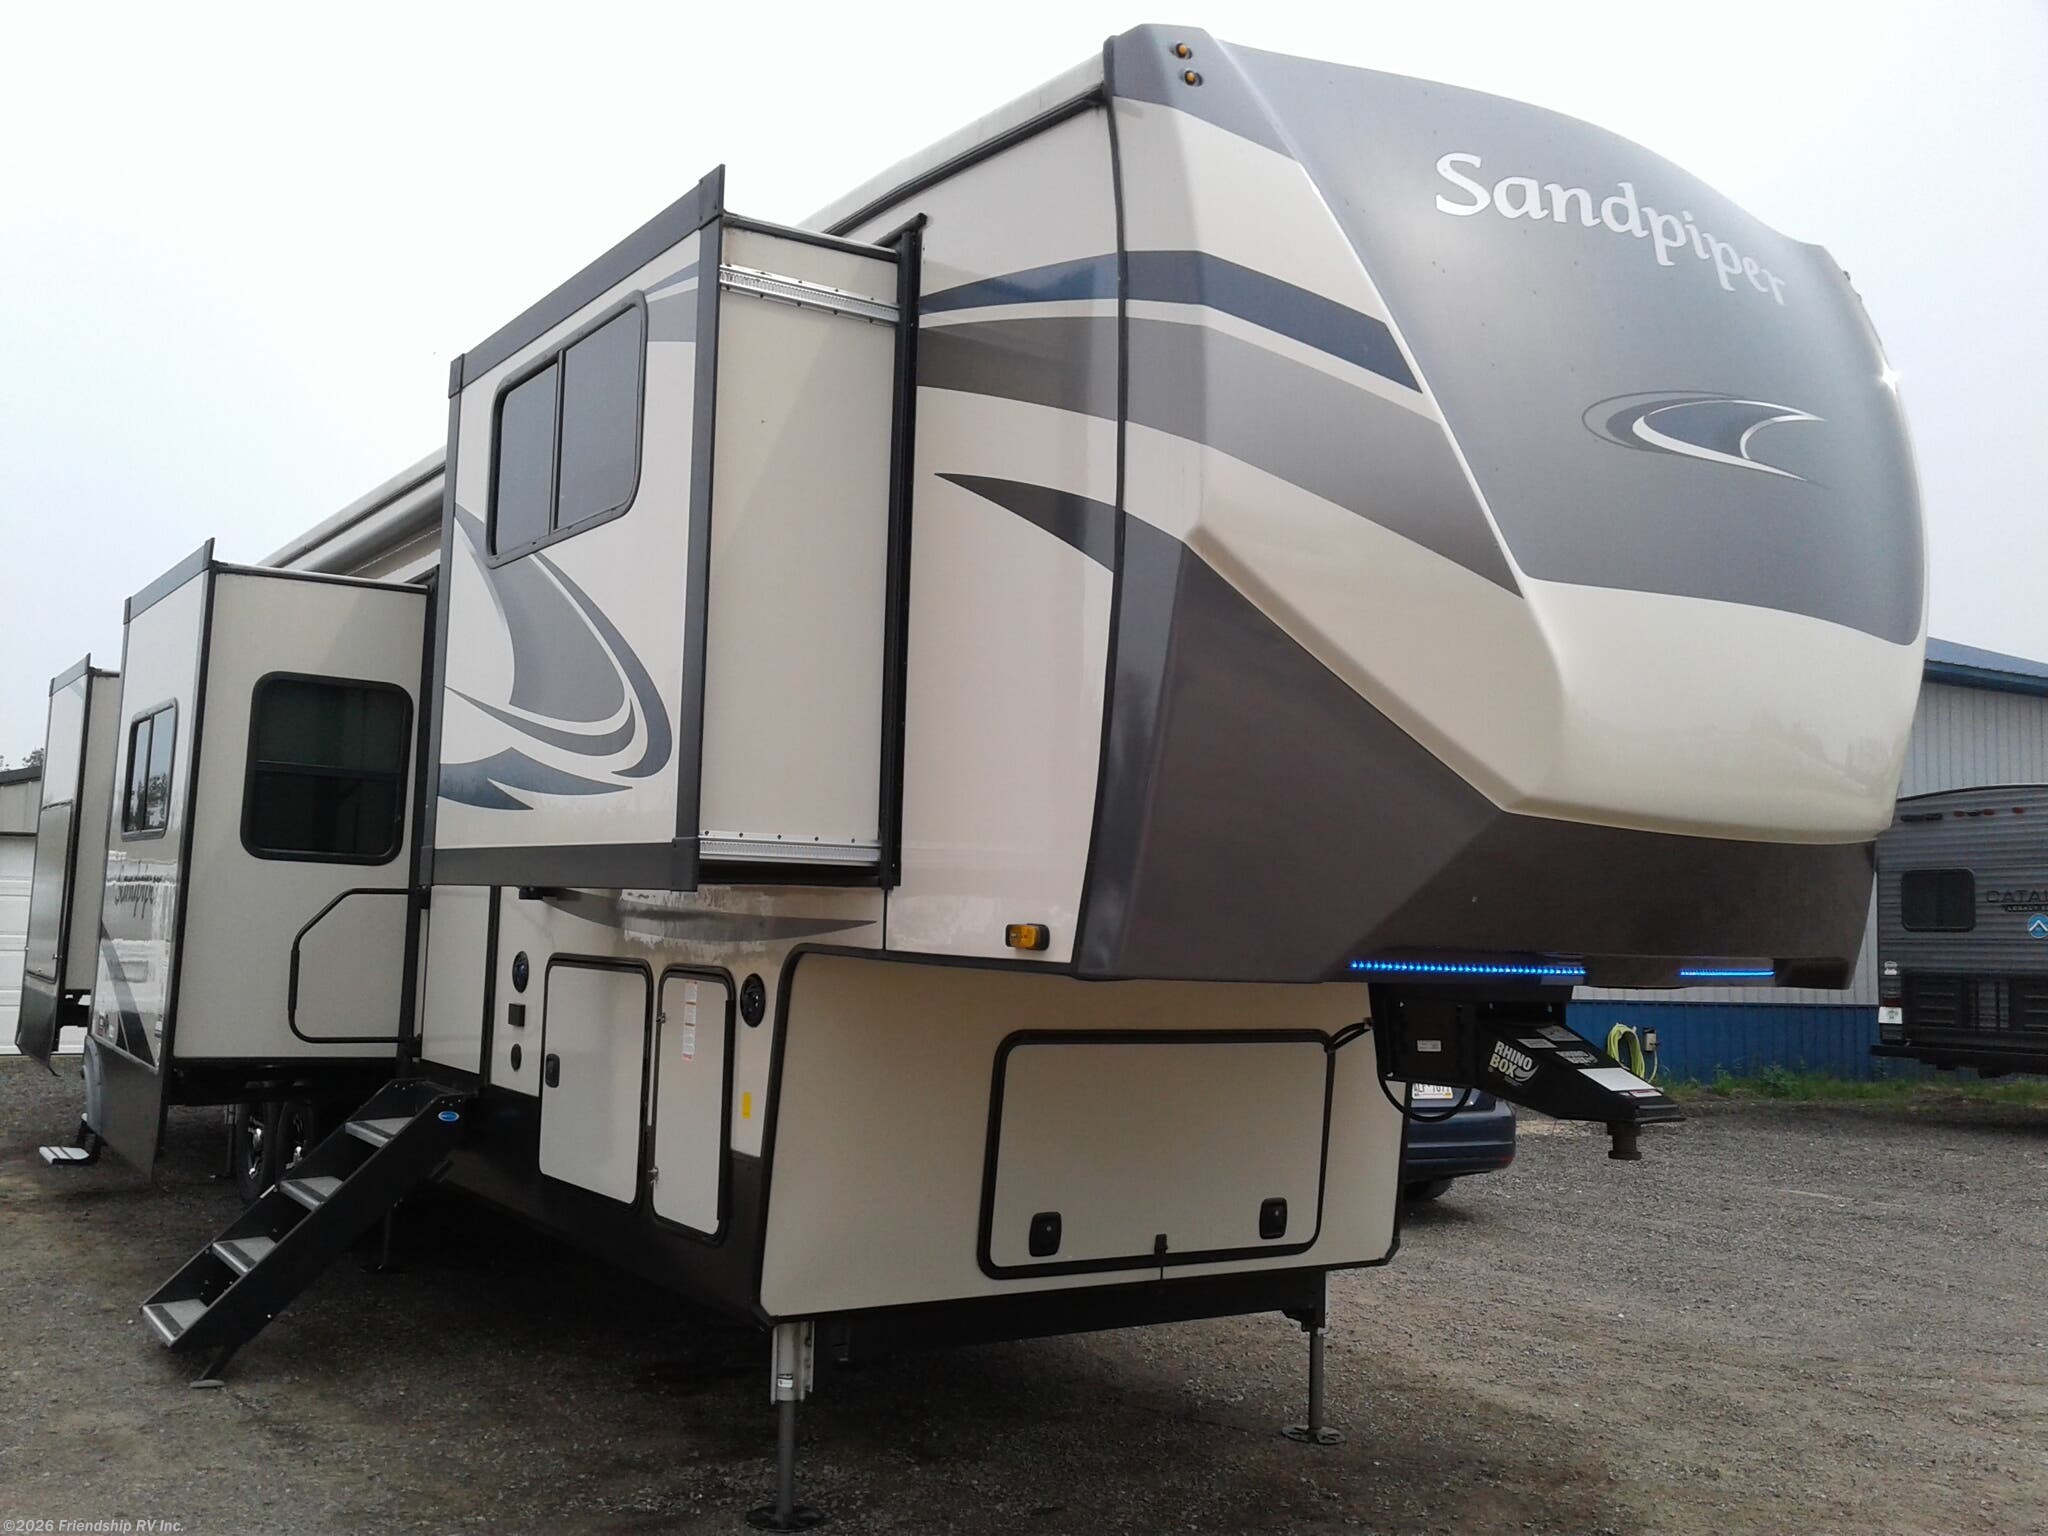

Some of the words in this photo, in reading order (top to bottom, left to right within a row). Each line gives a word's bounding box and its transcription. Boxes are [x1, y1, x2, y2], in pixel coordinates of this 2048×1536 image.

[1435, 152, 1786, 306] Sandpiper
[1489, 1053, 1518, 1078] BOX
[1494, 1040, 1533, 1071] RHINO
